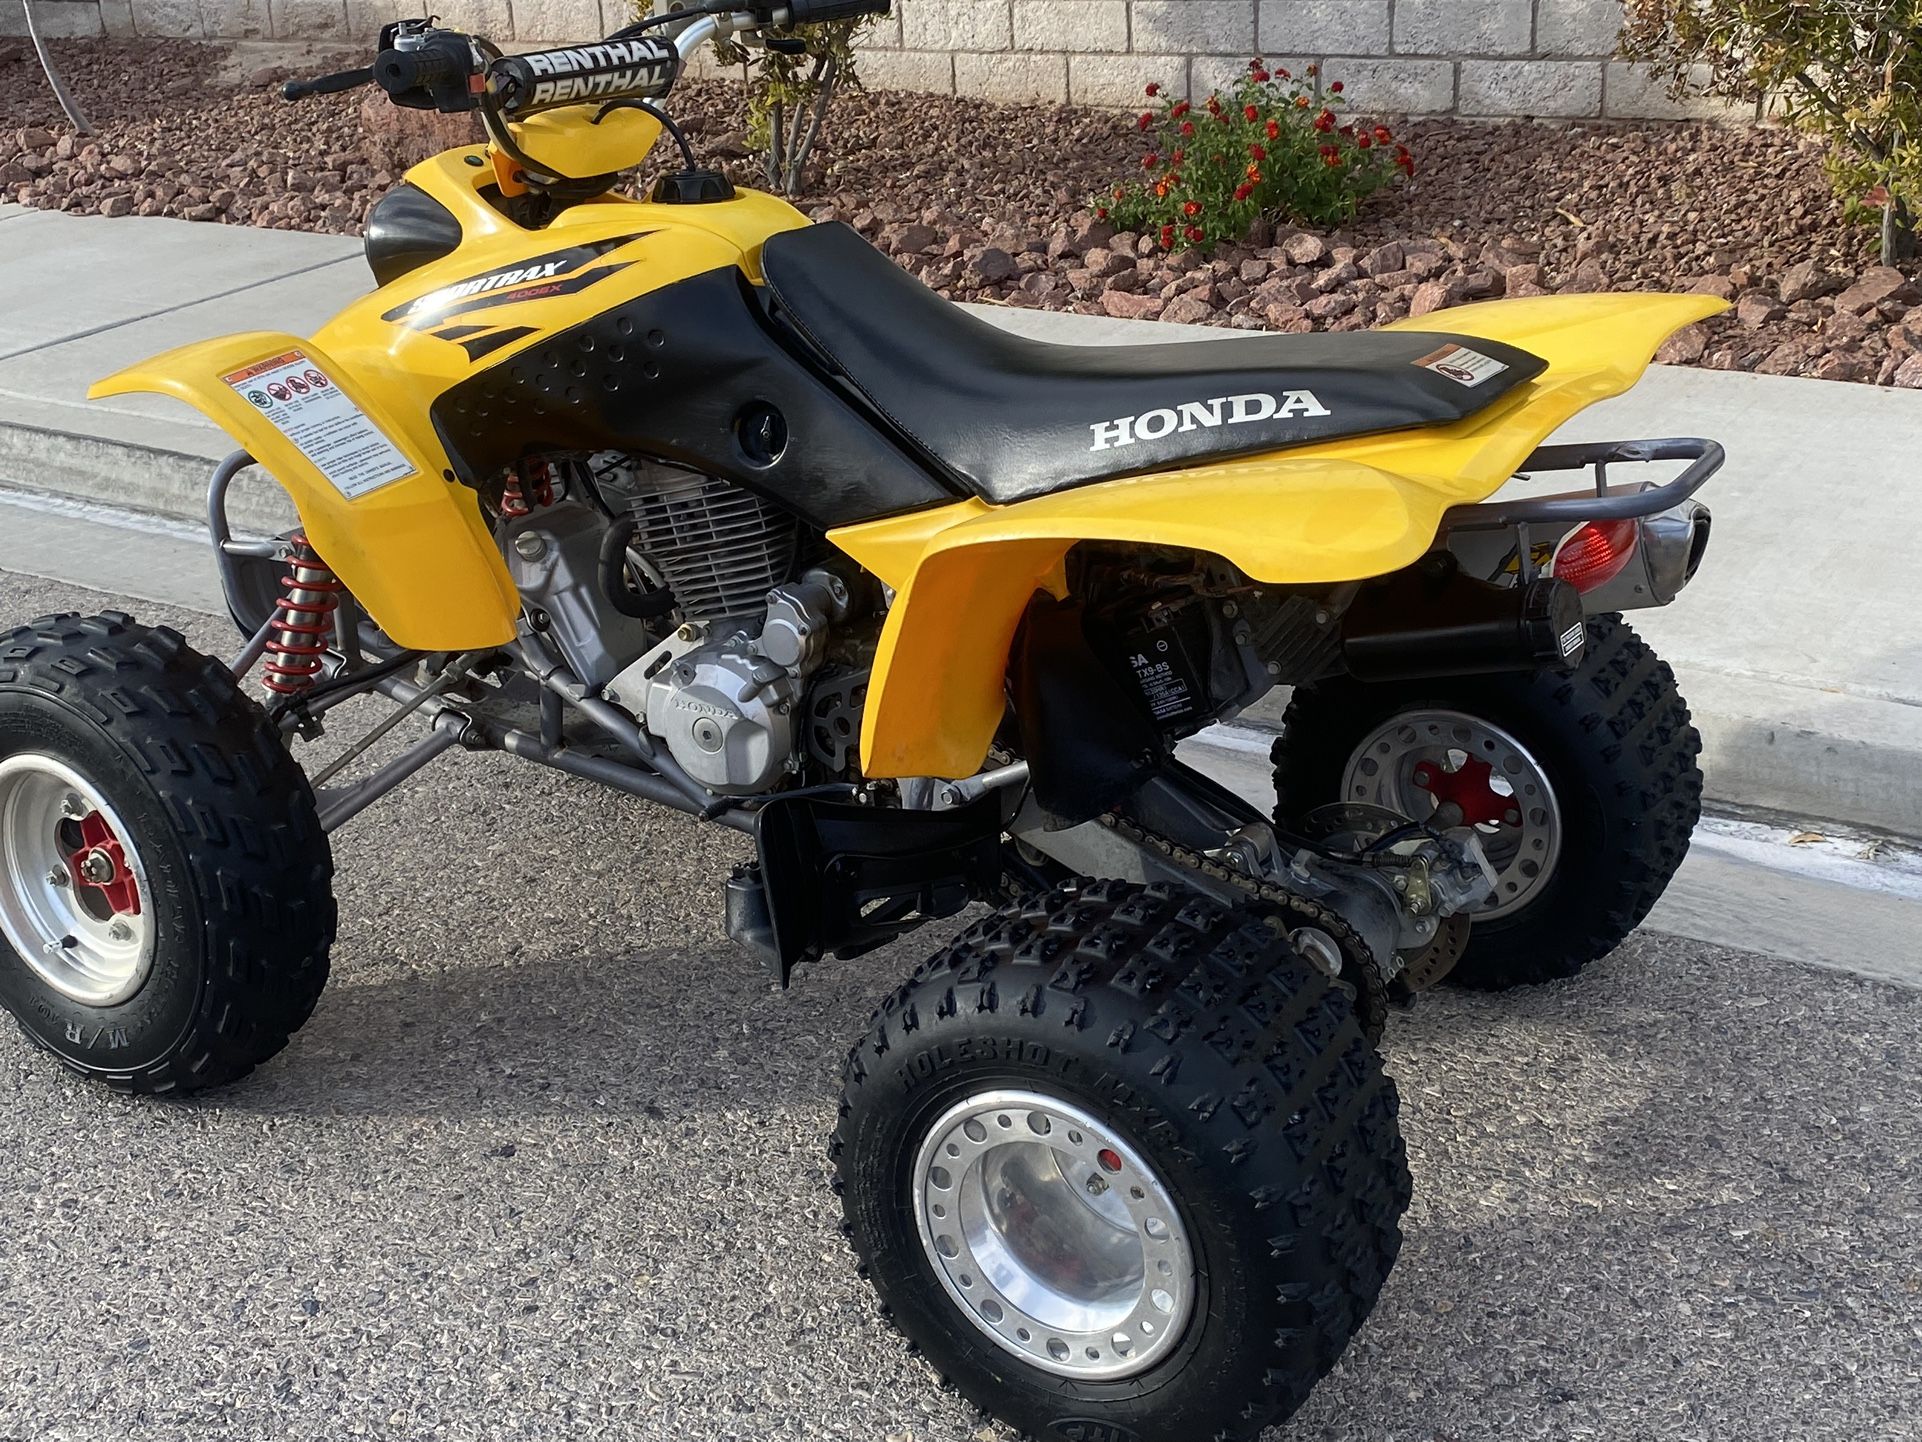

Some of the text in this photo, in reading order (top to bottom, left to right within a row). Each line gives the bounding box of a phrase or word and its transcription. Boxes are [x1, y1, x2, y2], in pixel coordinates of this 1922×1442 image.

[524, 39, 669, 76] RENTHAL
[531, 65, 666, 105] RENTHAL
[407, 260, 567, 314] SORTRAX
[1090, 390, 1331, 451] HONDA
[673, 698, 739, 720] HONDA
[895, 1036, 1081, 1093] HOLESHOT
